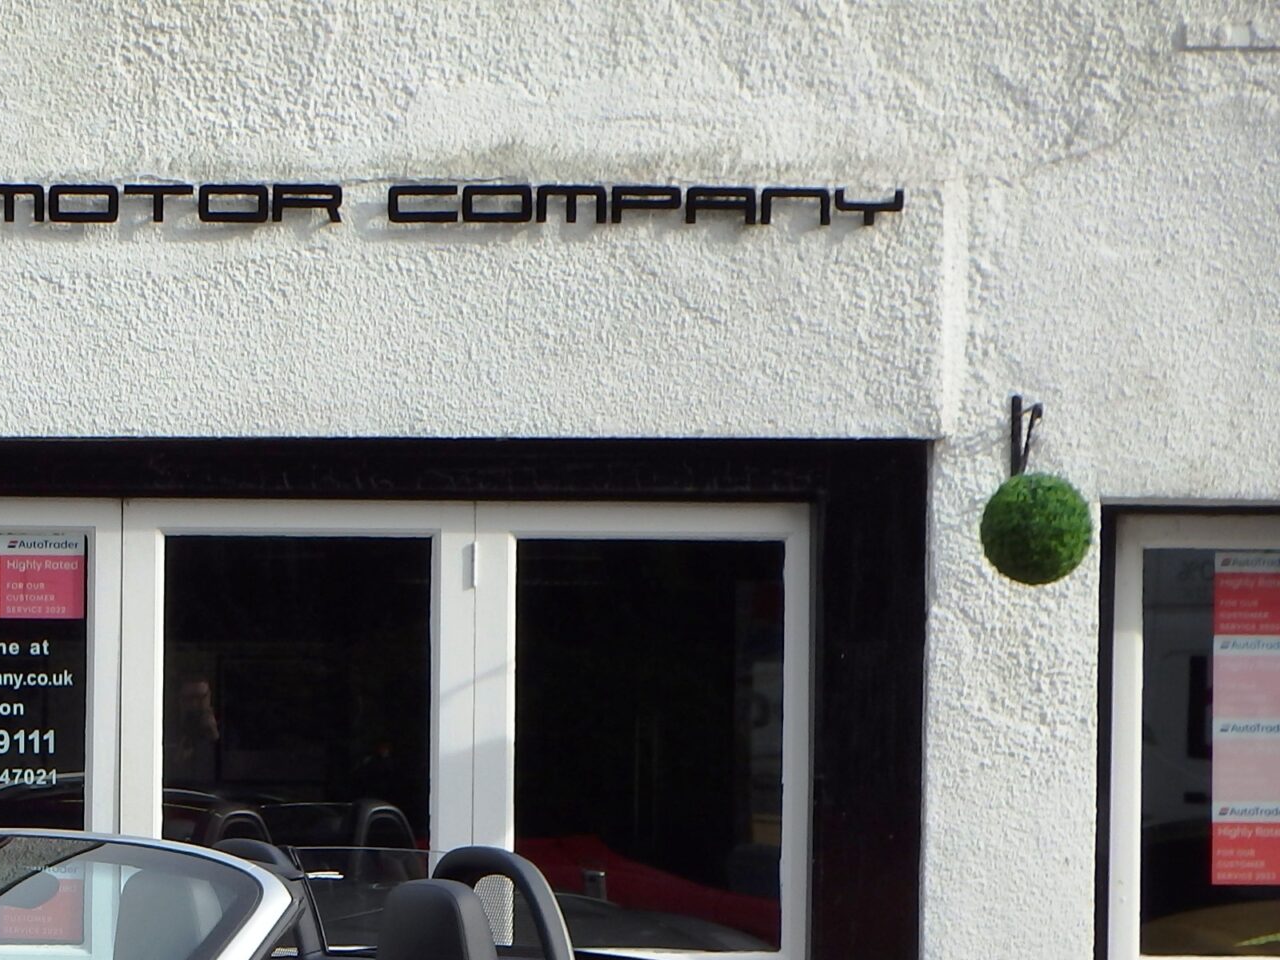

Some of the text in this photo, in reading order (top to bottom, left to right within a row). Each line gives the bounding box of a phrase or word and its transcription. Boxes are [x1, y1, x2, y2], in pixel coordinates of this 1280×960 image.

[387, 184, 905, 226] COMPANY
[18, 540, 79, 550] AutoTrader
[7, 560, 79, 572] Highly Rated
[6, 582, 45, 590] FOR OUR
[6, 594, 55, 602] CUSTOMER
[6, 606, 43, 614] SERVICE
[30, 640, 50, 655] at
[0, 703, 24, 715] on
